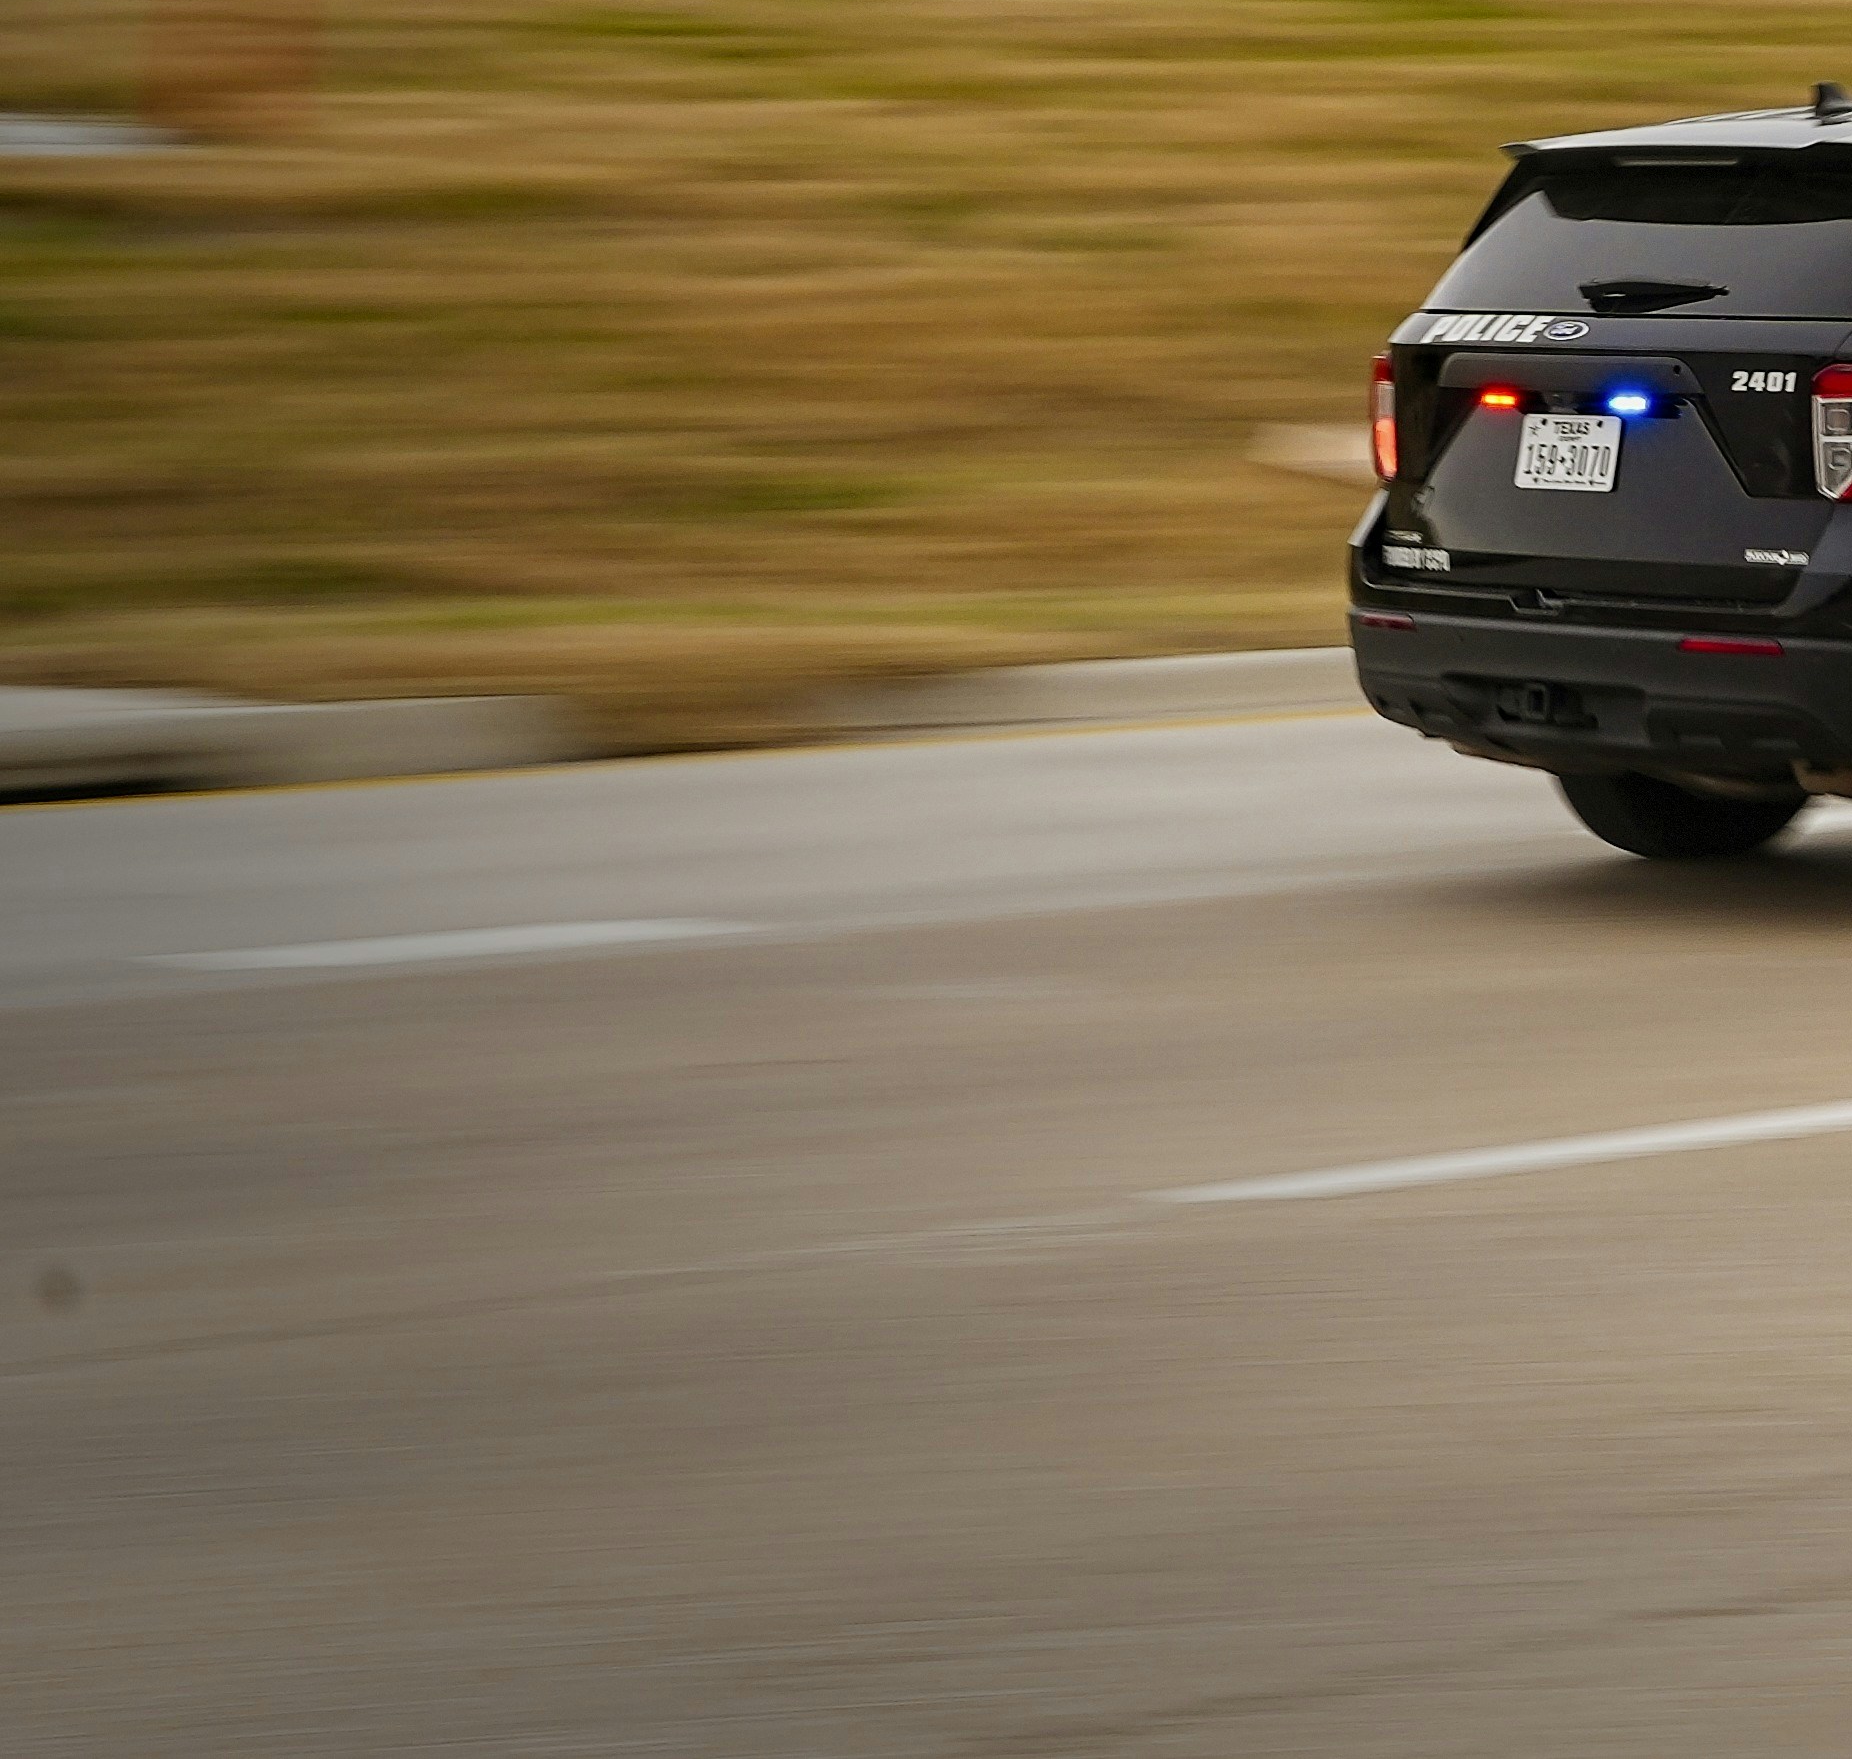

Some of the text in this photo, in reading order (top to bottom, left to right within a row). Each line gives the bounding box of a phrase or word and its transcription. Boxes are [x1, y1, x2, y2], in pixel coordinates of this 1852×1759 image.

[1420, 314, 1557, 343] POLICE
[1731, 370, 1798, 393] 2401
[1553, 420, 1590, 435] TEXAS
